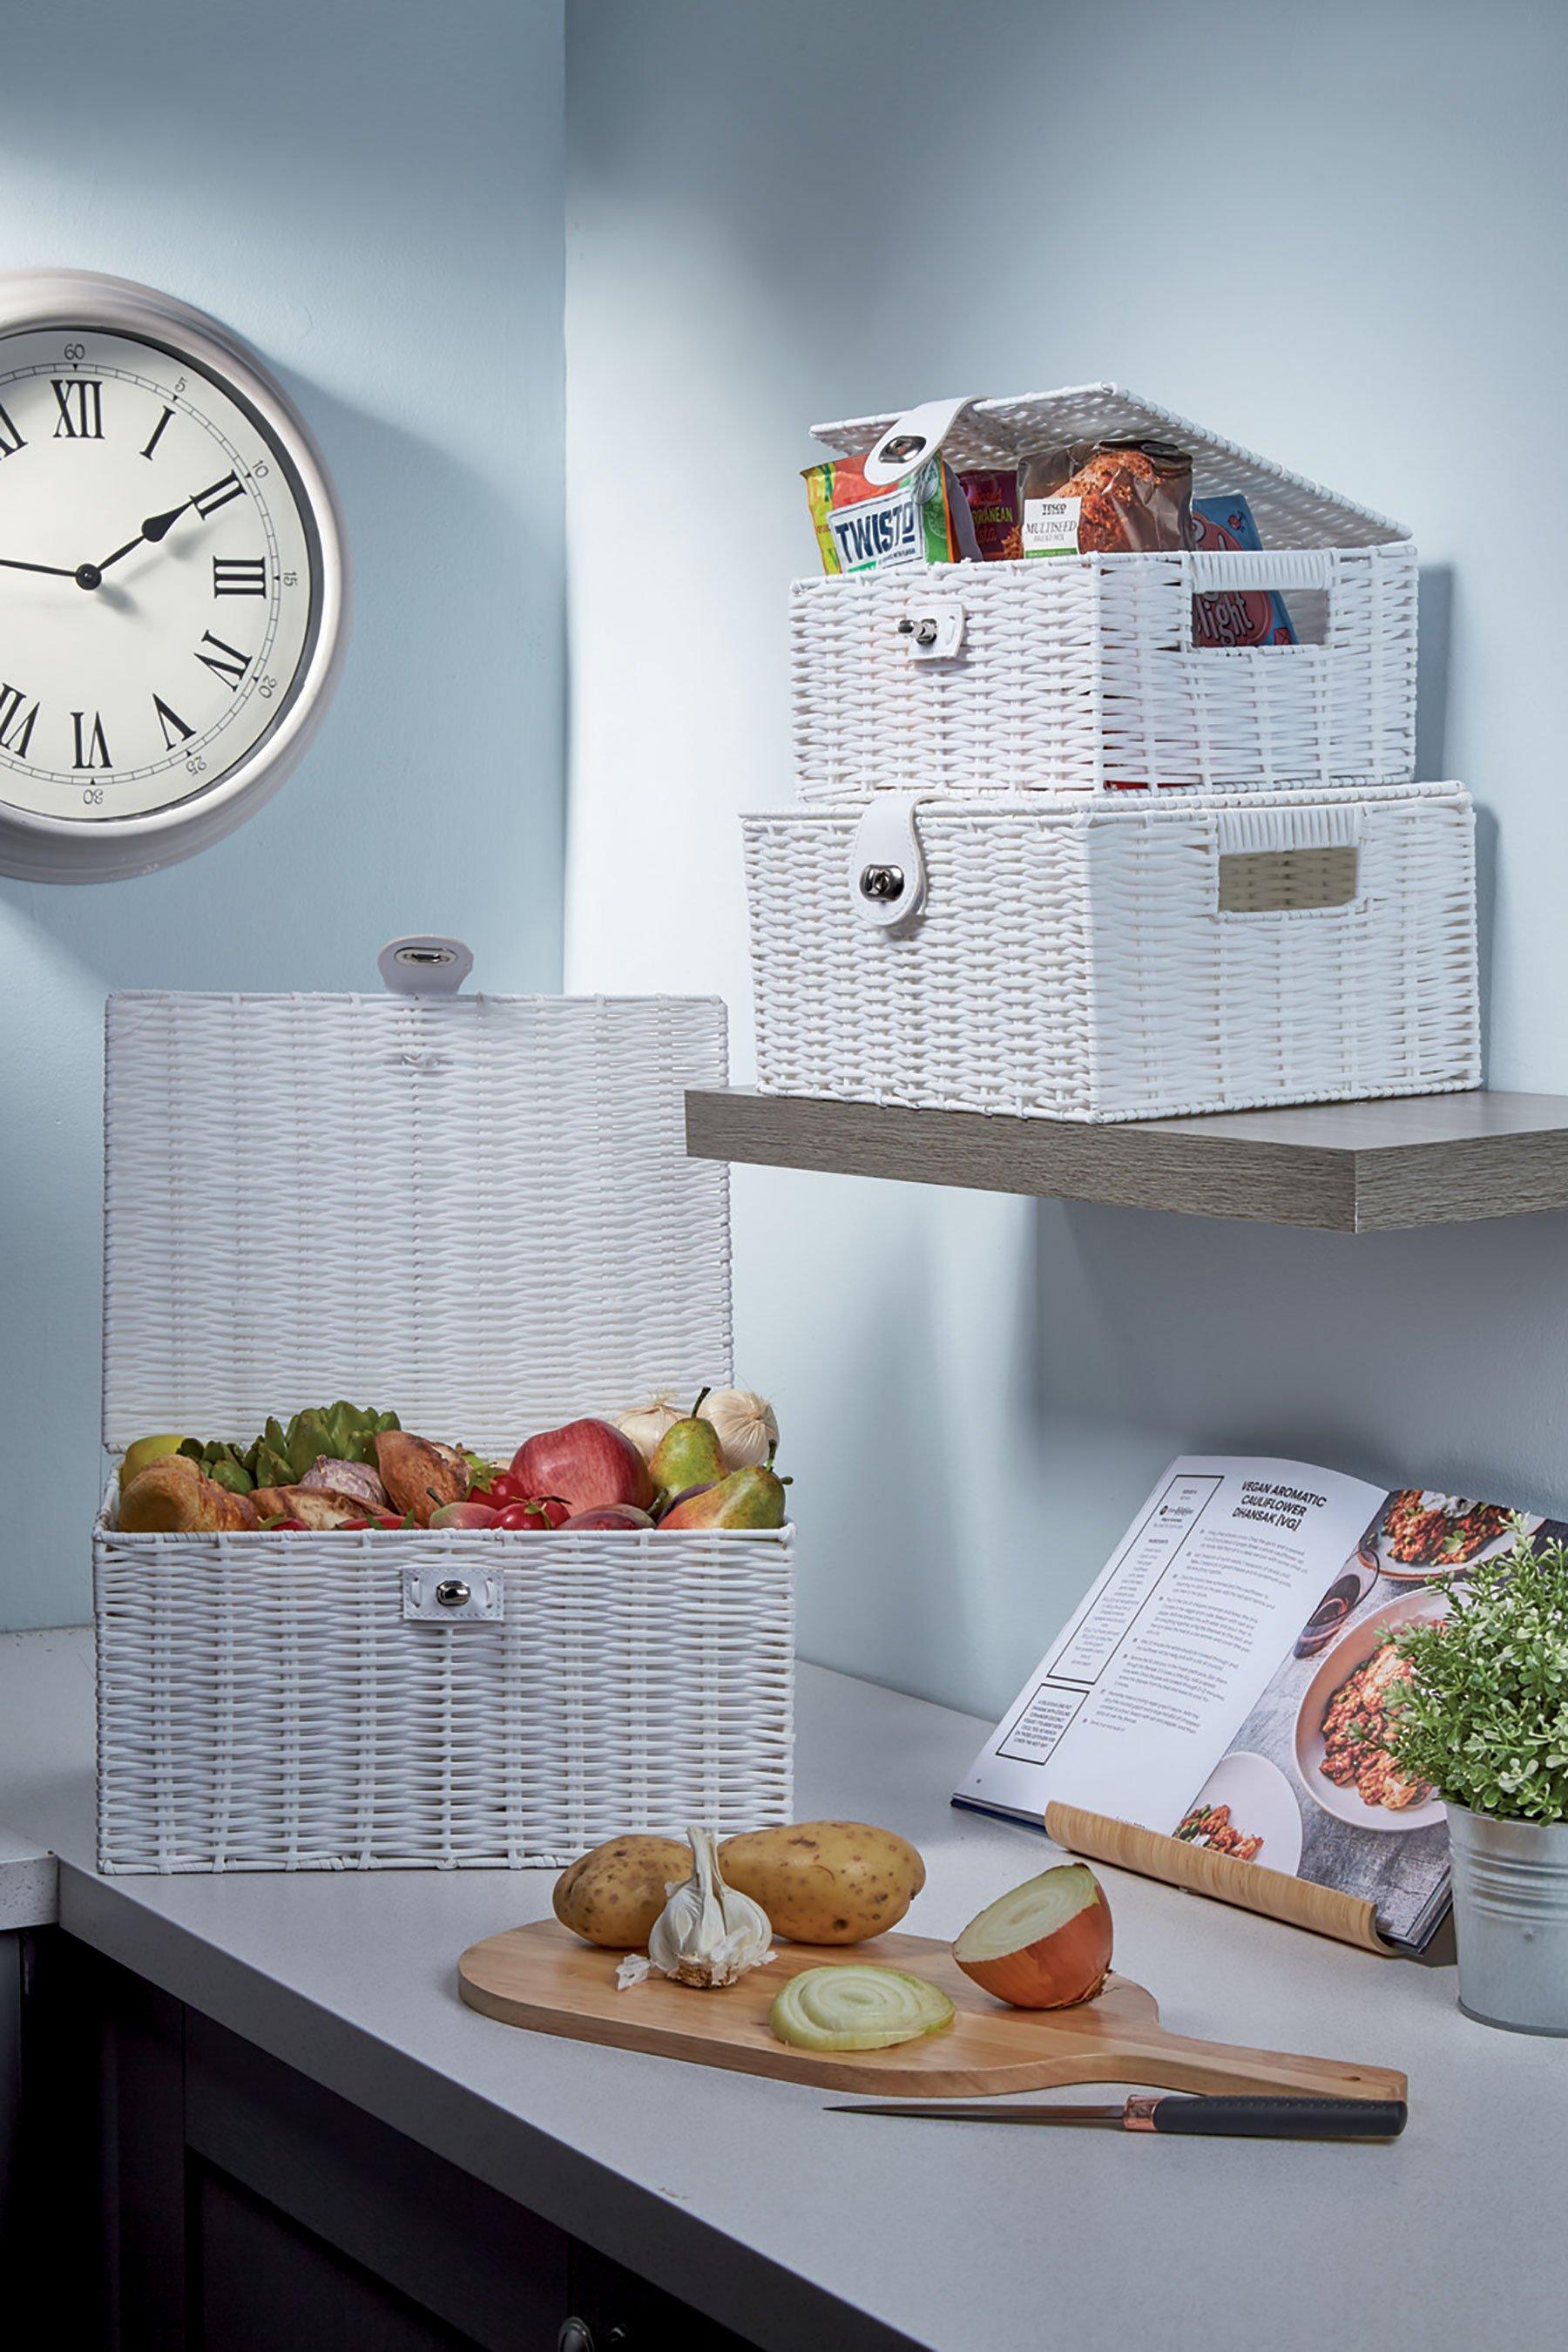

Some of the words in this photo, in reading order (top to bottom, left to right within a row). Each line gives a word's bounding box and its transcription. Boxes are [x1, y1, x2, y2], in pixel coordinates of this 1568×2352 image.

[64, 343, 86, 360] 60
[174, 376, 188, 392] 5
[51, 379, 105, 440] XII
[139, 405, 176, 461] I
[252, 459, 270, 479] 10
[189, 469, 248, 521] II
[1042, 503, 1067, 512] TESCO
[213, 555, 267, 599] III
[283, 571, 298, 587] 15
[193, 629, 253, 693] IV
[258, 674, 277, 700] 20
[152, 693, 197, 752] V
[70, 710, 113, 769] VI
[186, 754, 208, 776] 25
[83, 788, 104, 805] 30
[1240, 1494, 1308, 1517] CAULIFLOWER
[1241, 1480, 1273, 1494] VEGAN
[1270, 1484, 1328, 1508] AROMATIC
[1232, 1507, 1278, 1524] DHANSAK
[1274, 1513, 1302, 1531] [VG]
